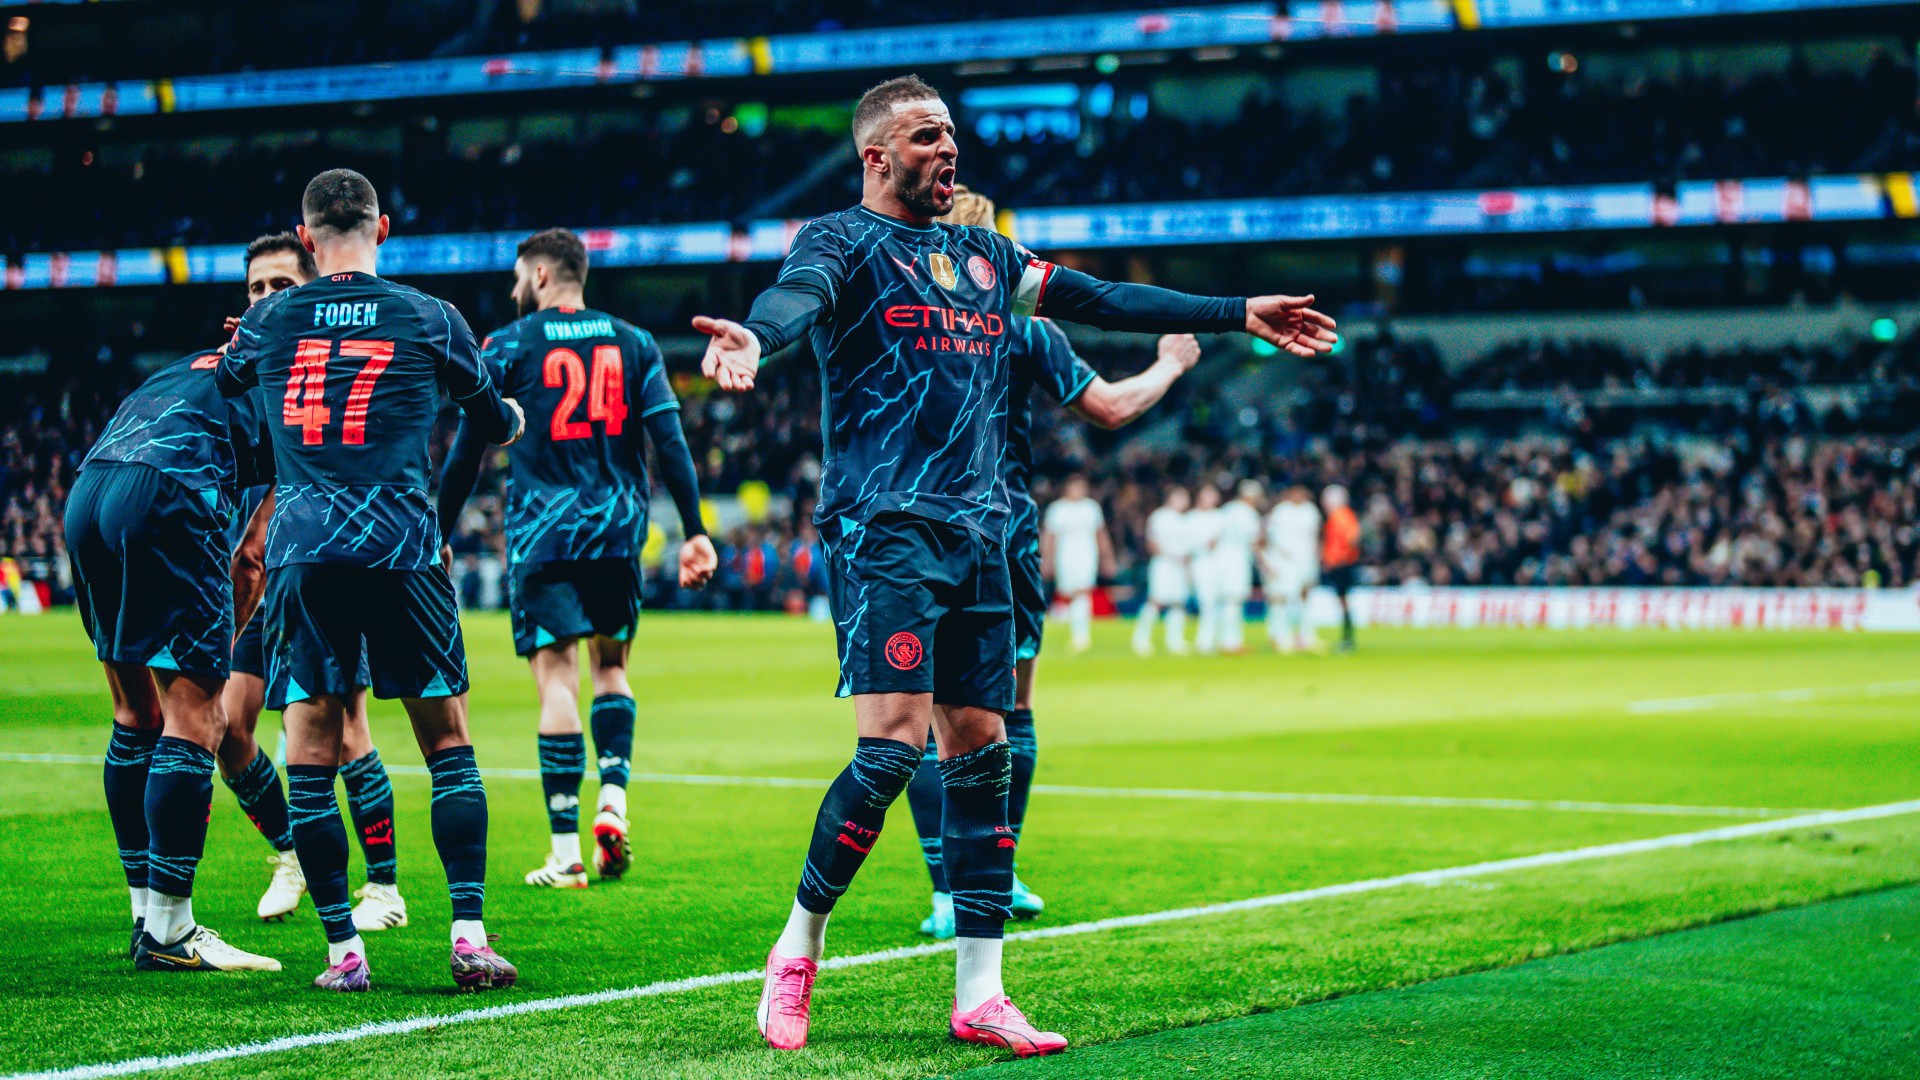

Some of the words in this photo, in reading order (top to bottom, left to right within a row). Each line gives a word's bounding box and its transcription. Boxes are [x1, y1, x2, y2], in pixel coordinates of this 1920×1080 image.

[331, 274, 353, 282] CITY
[314, 303, 378, 326] FODEN
[884, 305, 1004, 337] ETIHAD
[915, 335, 991, 357] AIRWAYS
[283, 339, 395, 445] 47
[542, 344, 629, 442] 24
[844, 820, 879, 838] CIT
